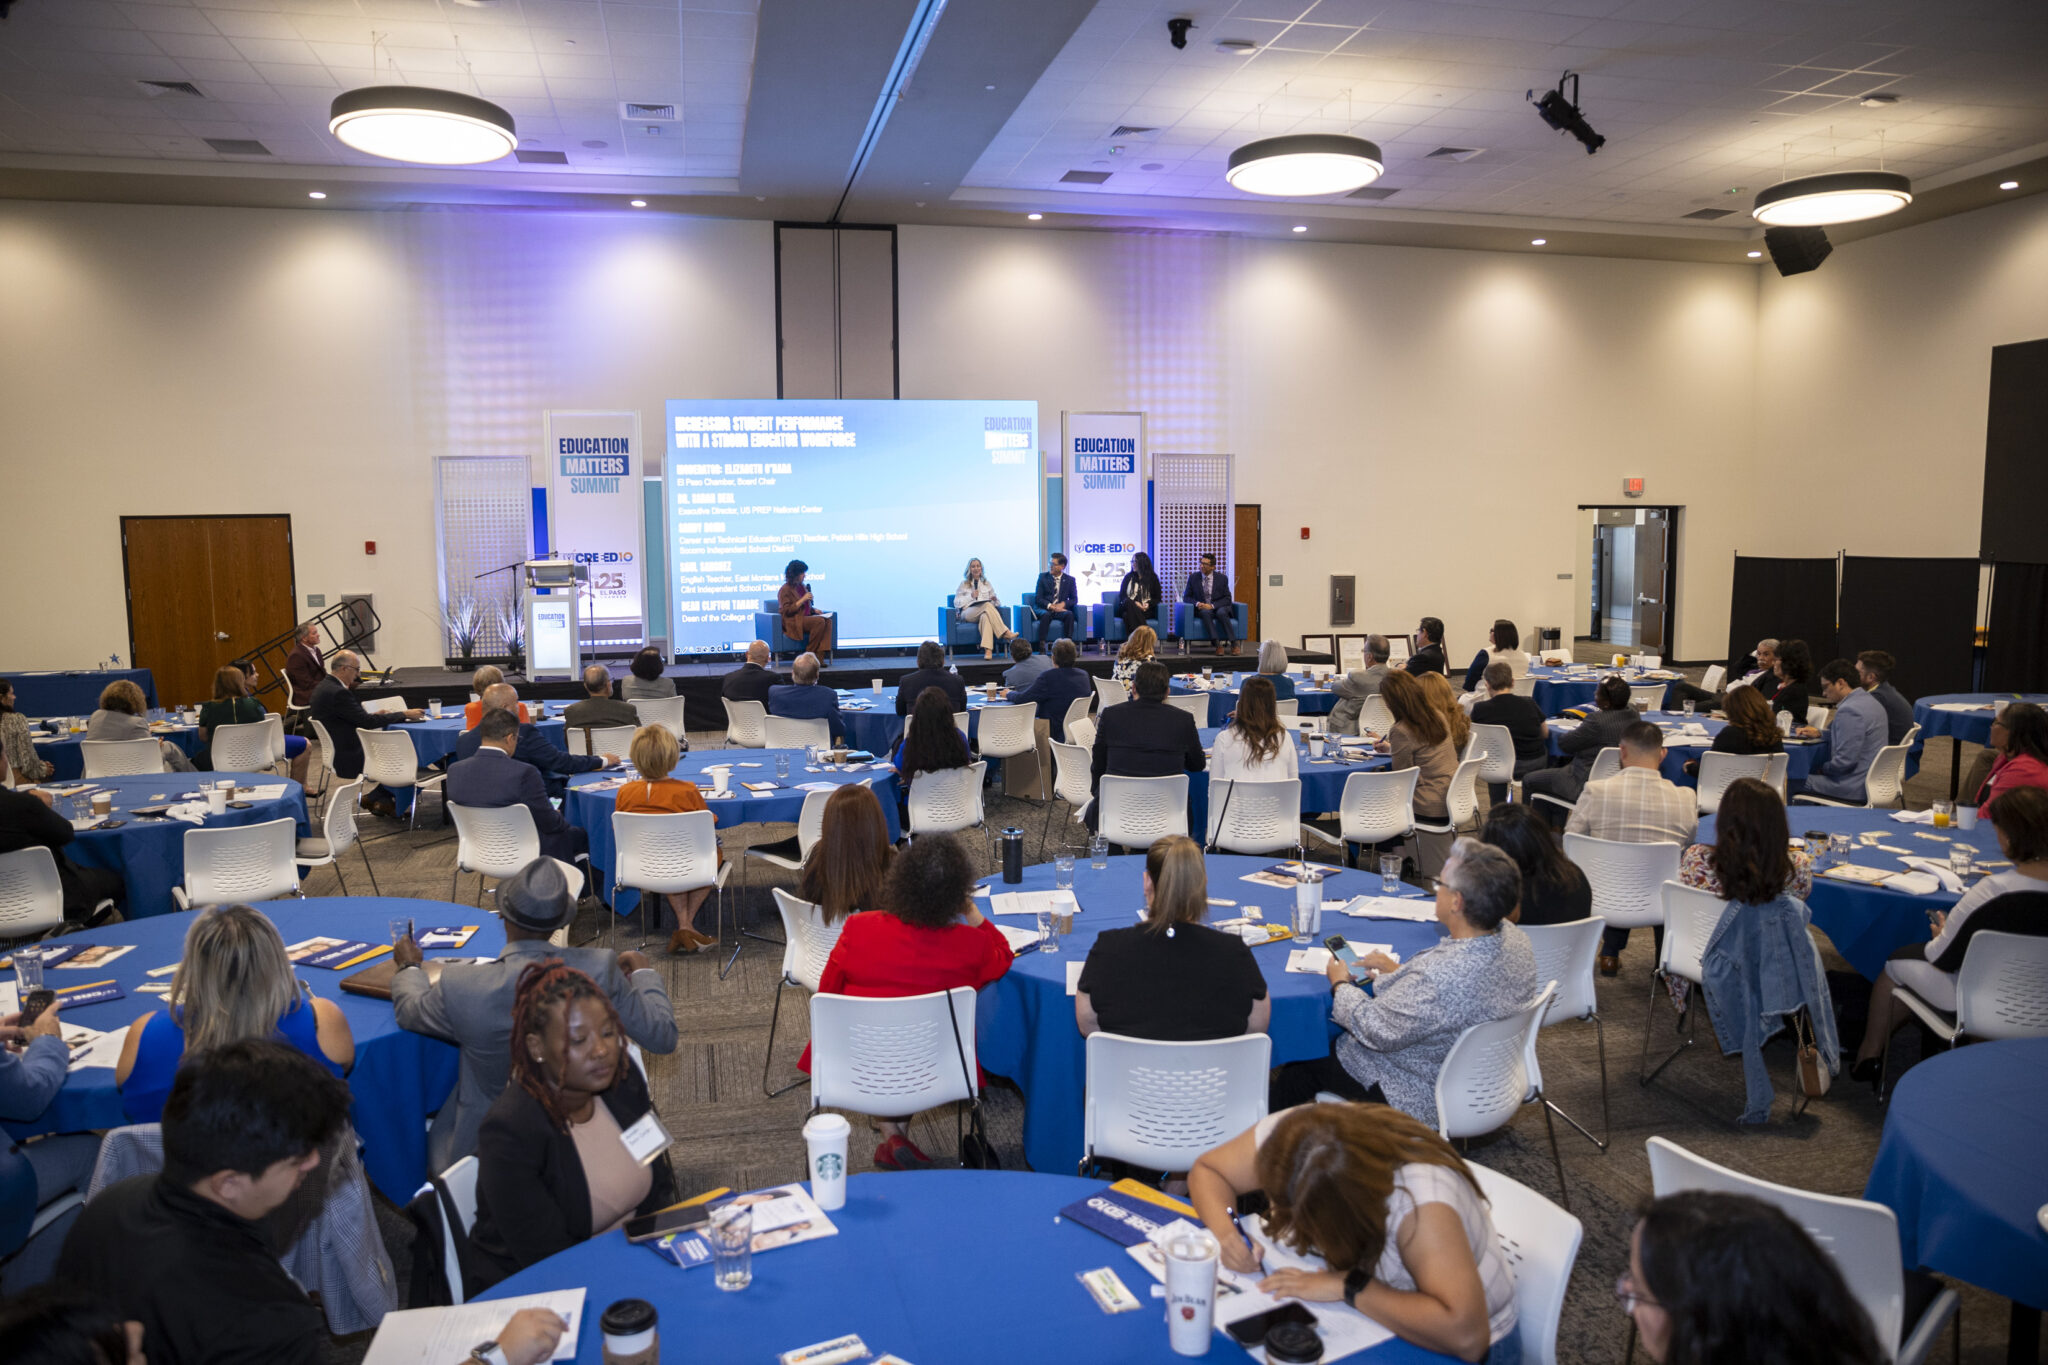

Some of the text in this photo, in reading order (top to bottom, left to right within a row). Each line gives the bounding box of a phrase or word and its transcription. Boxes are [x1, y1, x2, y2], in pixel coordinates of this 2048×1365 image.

[984, 416, 1032, 431] EDUCATION
[559, 438, 629, 454] EDUCATION
[702, 433, 710, 448] A
[1074, 438, 1135, 453] EDUCATION
[565, 457, 624, 474] MATTERS
[1079, 456, 1130, 471] MATTERS
[571, 477, 620, 494] SUMMIT
[738, 478, 757, 486] Board
[1083, 474, 1127, 490] SUMMIT
[752, 506, 772, 514] PREP
[697, 584, 738, 594] Independent
[739, 583, 761, 592] School
[682, 614, 700, 623] Dean
[701, 614, 708, 622] of
[709, 614, 719, 622] the
[721, 613, 746, 622] College
